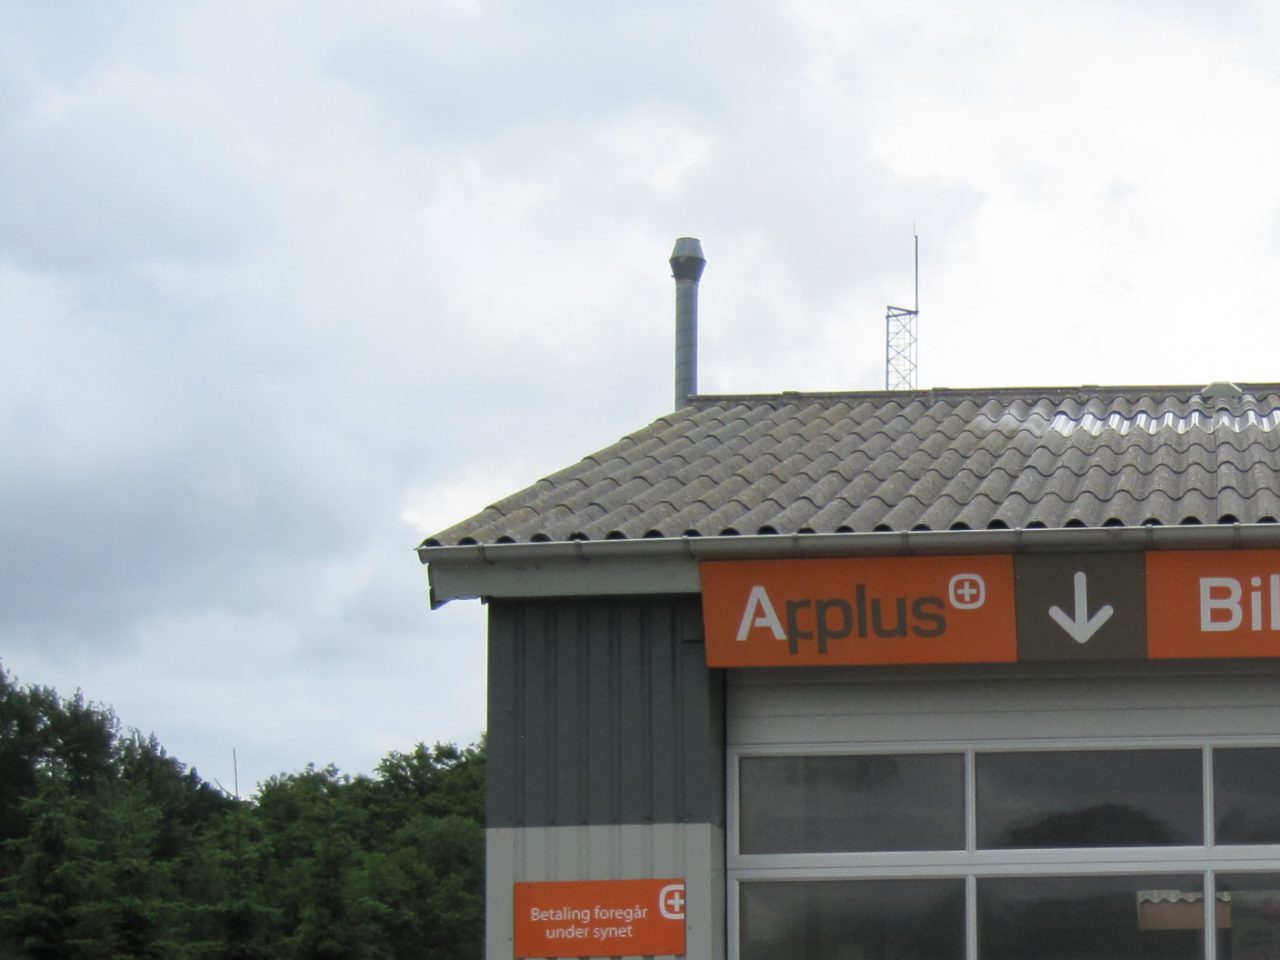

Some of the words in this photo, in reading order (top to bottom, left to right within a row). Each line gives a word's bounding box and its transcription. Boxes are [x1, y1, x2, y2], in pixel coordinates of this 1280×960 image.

[530, 907, 591, 923] Betaling
[594, 904, 648, 921] foregår
[546, 924, 588, 939] under
[593, 926, 633, 941] synet
